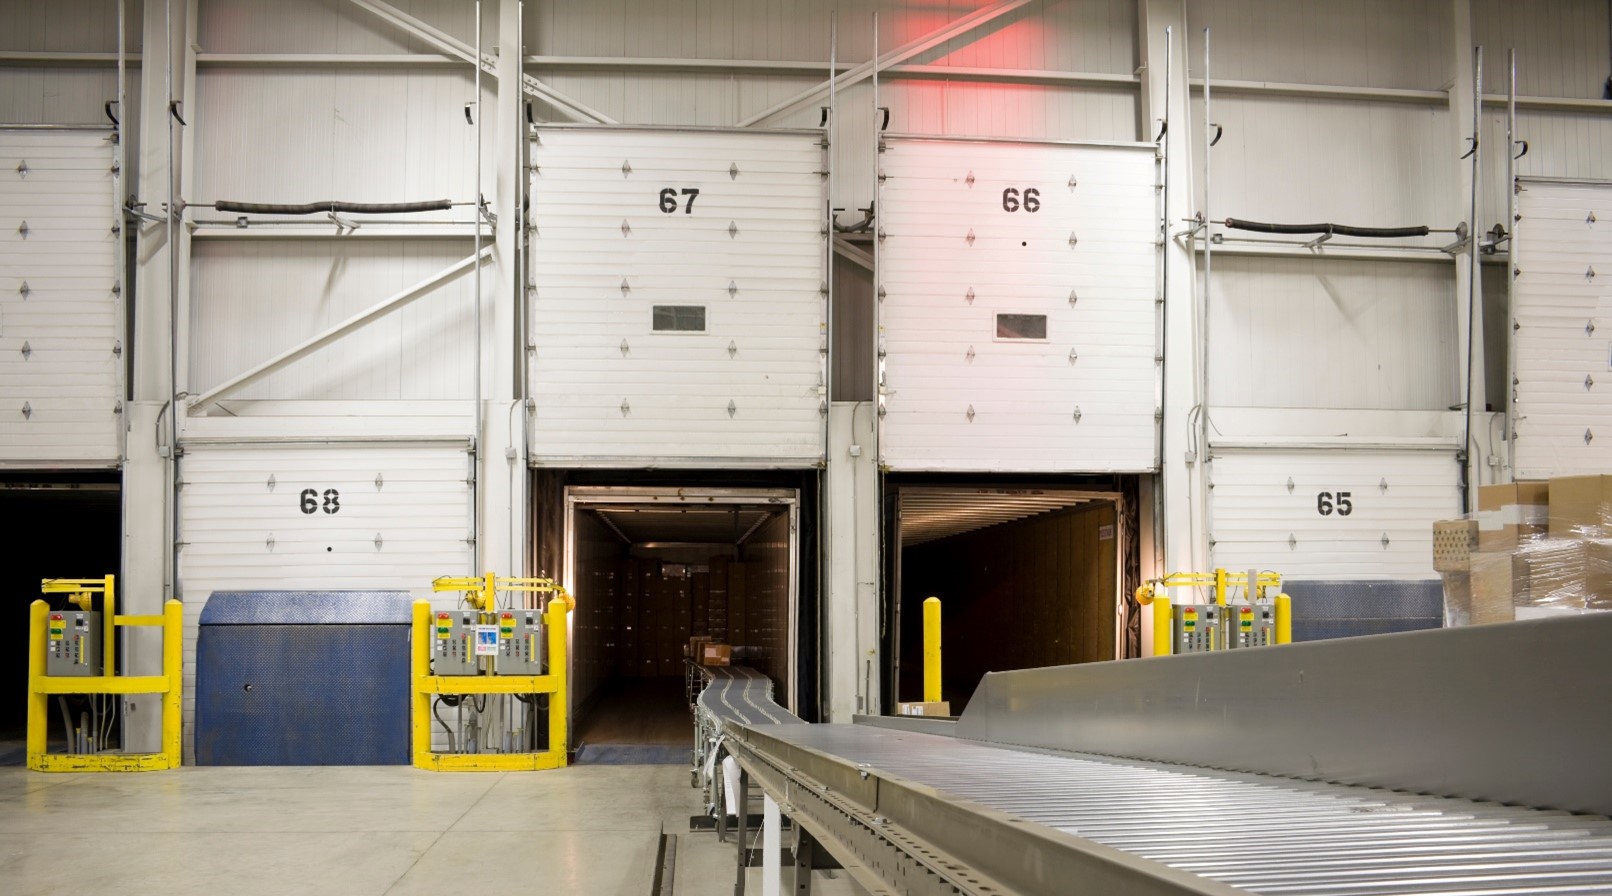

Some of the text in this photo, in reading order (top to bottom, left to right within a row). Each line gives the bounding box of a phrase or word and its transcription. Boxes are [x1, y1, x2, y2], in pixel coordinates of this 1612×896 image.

[660, 187, 699, 215] 67
[1003, 188, 1040, 213] 66
[299, 488, 340, 515] 68
[1317, 492, 1353, 516] 65
